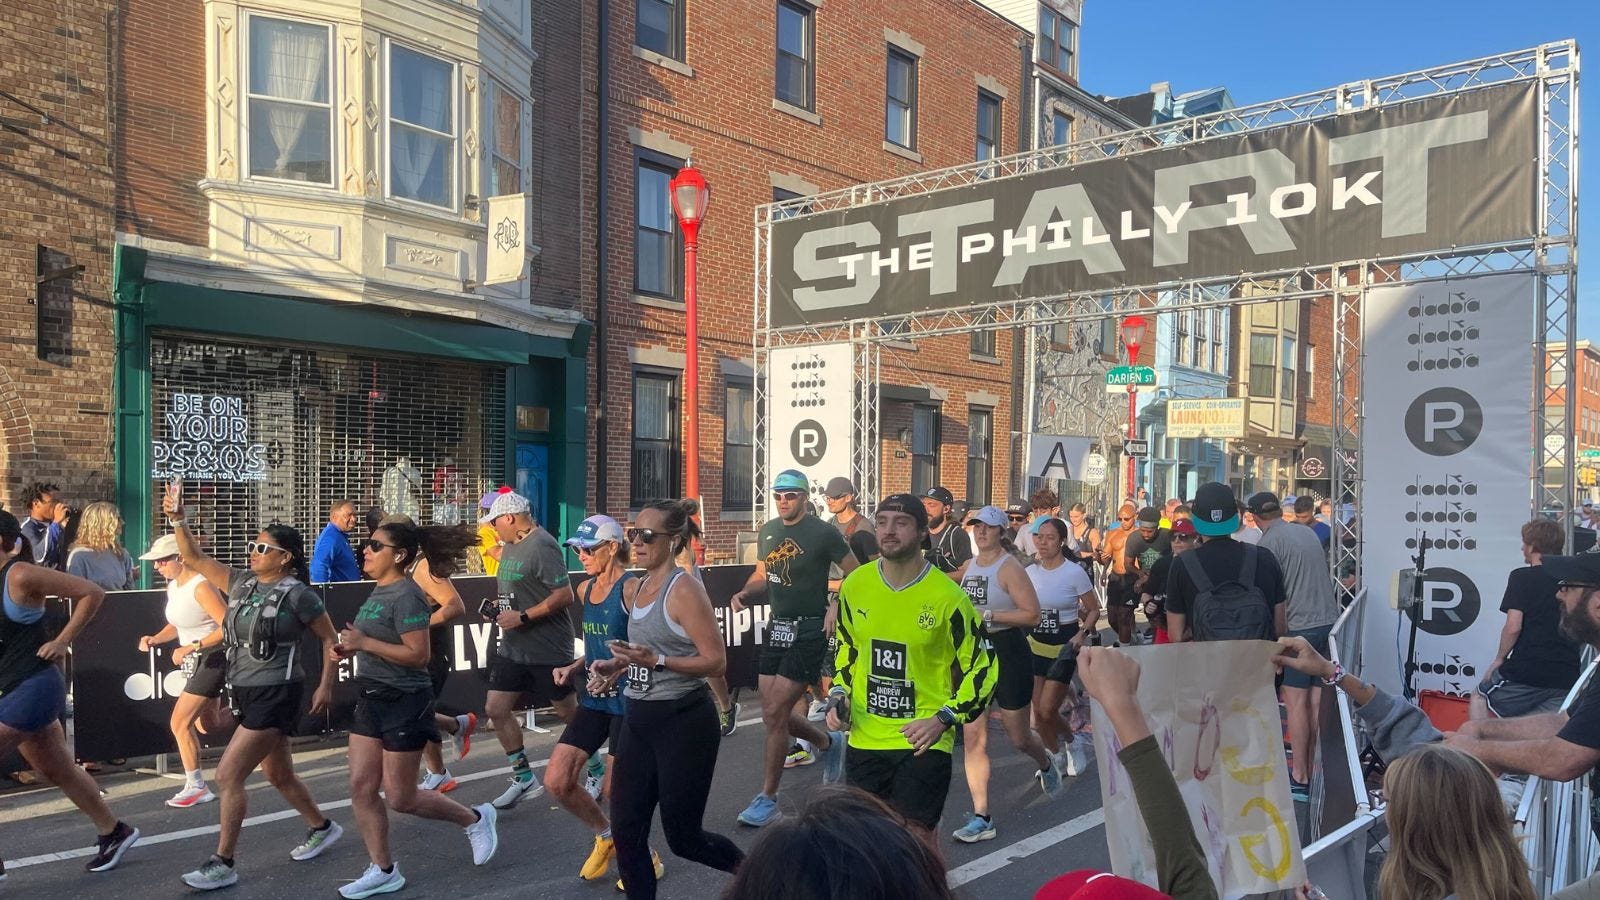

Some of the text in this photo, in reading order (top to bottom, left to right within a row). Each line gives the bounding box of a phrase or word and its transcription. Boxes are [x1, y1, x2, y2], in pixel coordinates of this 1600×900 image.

[793, 110, 1488, 311] START
[838, 170, 1382, 280] THE PHILLY 10K
[1107, 372, 1153, 384] DARIEN ST
[173, 393, 204, 414] BE
[210, 396, 242, 416] ON
[166, 413, 248, 442] YOUR
[1424, 401, 1465, 442] R
[799, 429, 819, 457] R
[1041, 441, 1071, 479] A
[918, 612, 935, 626] BVB
[1040, 619, 1056, 628] 35
[874, 648, 903, 670] 1&1
[869, 692, 911, 710] 3864
[876, 686, 901, 697] ANDREW
